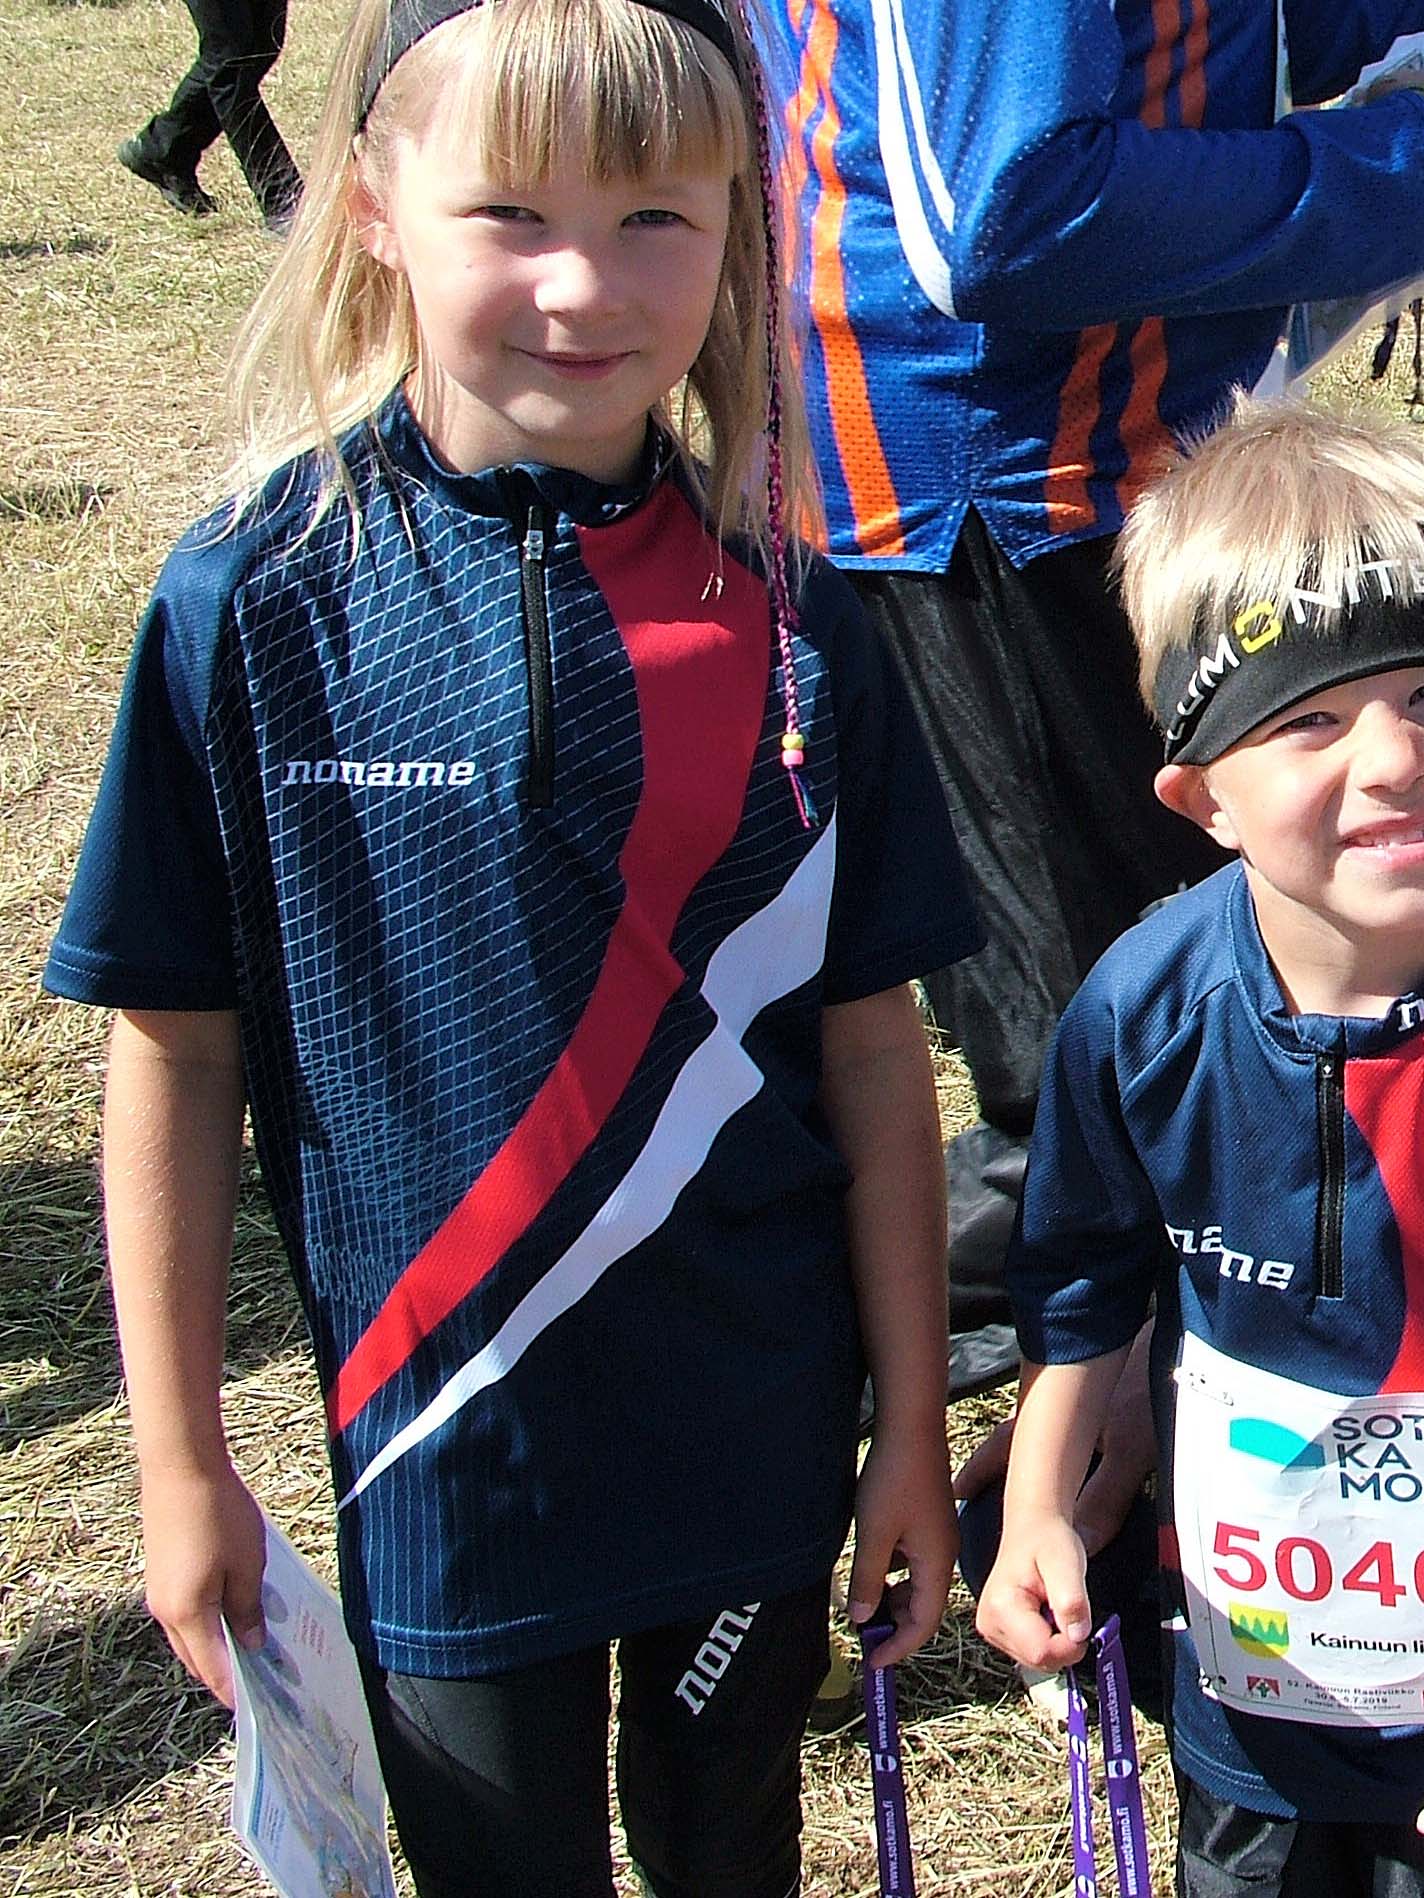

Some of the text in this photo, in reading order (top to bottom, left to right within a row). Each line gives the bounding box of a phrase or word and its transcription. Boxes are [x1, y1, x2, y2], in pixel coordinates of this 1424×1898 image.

[281, 759, 476, 787] noname
[1337, 1442, 1412, 1469] KA
[674, 1601, 761, 1715] non
[1310, 1631, 1407, 1653] Kainuun
[882, 1800, 899, 1890] www.sotkamo.fi
[1116, 1807, 1137, 1896] www.sotkamo.fi
